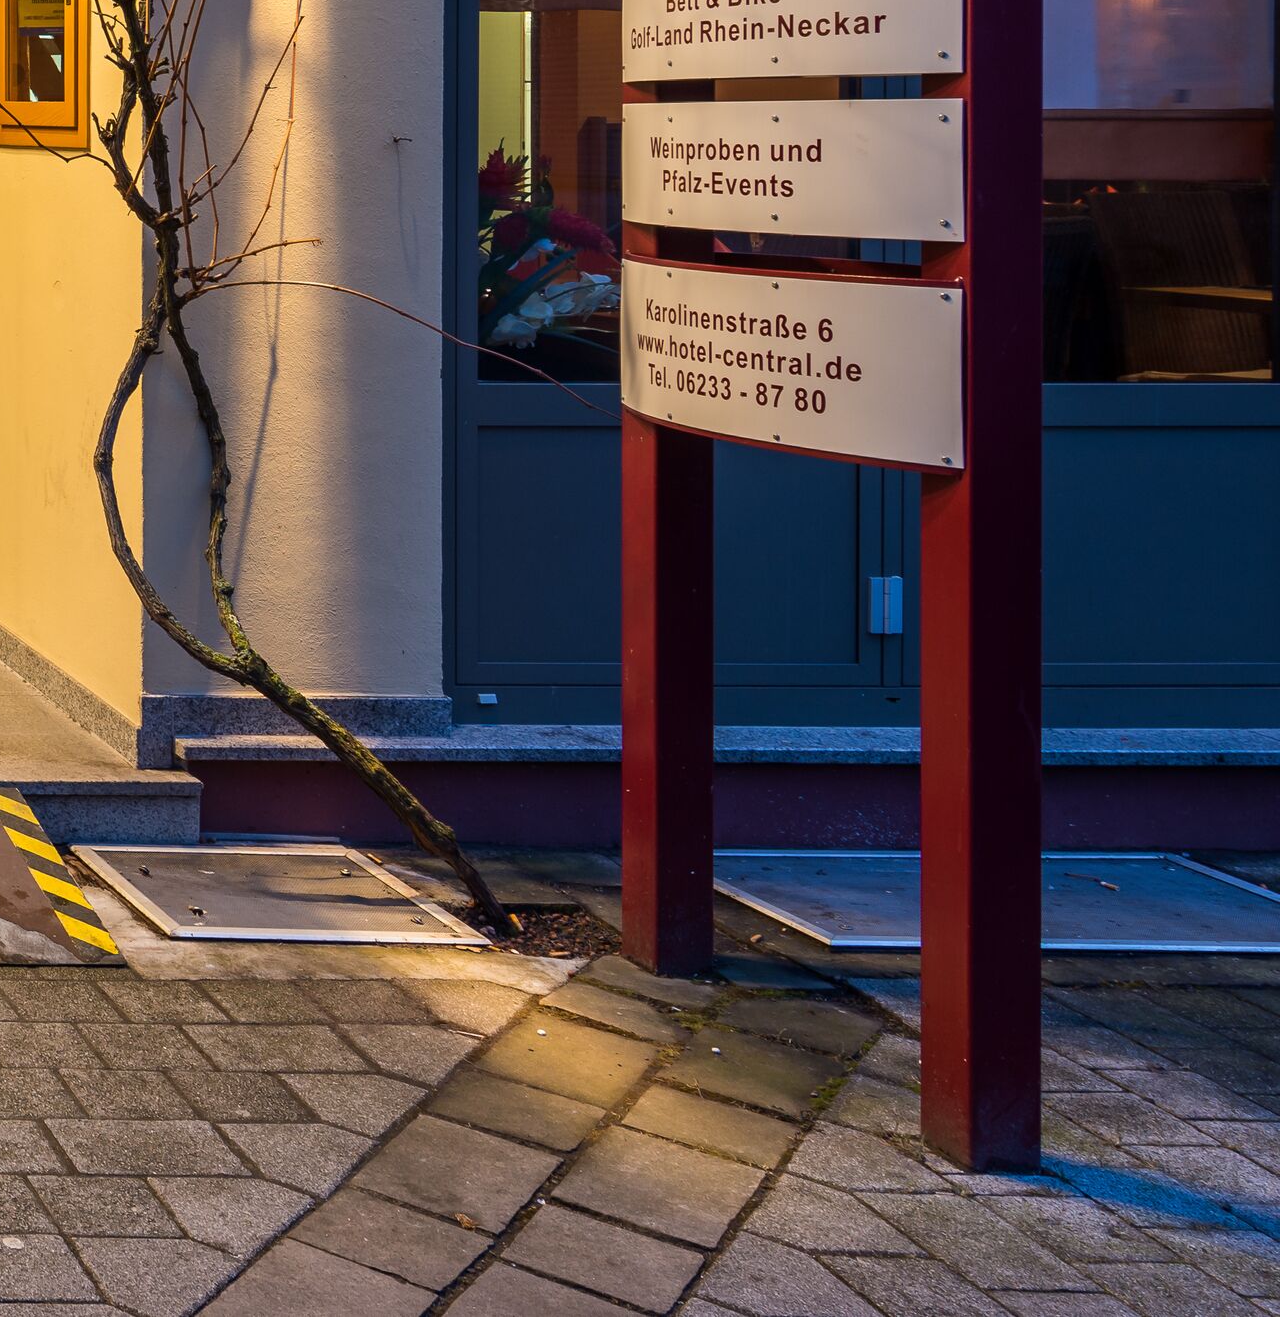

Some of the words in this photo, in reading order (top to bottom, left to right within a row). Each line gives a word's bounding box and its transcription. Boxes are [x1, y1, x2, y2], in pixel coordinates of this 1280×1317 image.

[630, 22, 693, 50] Golf-Land
[700, 11, 887, 43] Rhein-Neckar
[650, 136, 760, 165] Weinproben
[770, 139, 823, 163] und
[662, 169, 794, 198] Pfalz-Events
[646, 298, 807, 340] Karolinenstraße
[818, 319, 833, 343] 6
[638, 332, 863, 383] www.hotel-central.de
[649, 364, 671, 390] Tel.
[676, 370, 732, 401] 06233
[755, 382, 784, 409] 87
[794, 387, 826, 415] 80
